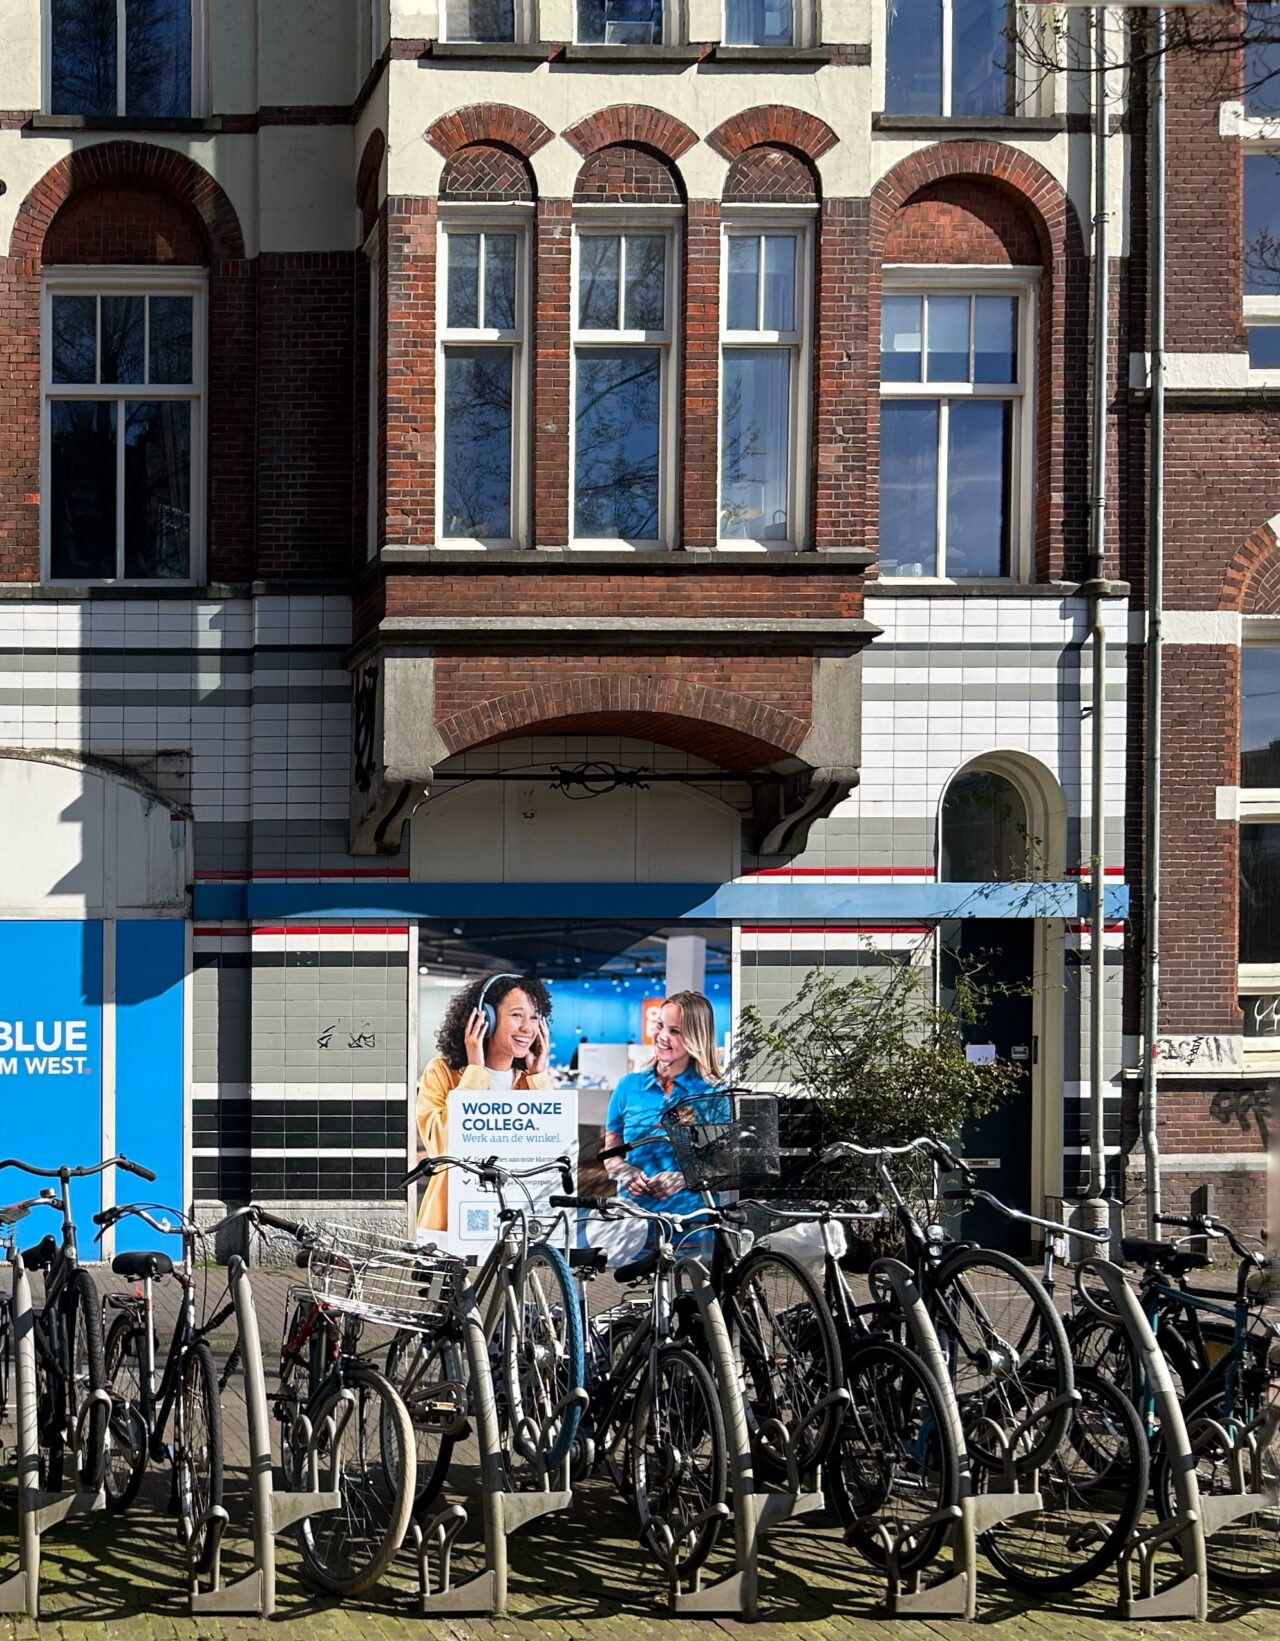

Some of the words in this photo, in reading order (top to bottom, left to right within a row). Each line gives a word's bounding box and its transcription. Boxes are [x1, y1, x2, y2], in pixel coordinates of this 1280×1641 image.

[462, 1102, 513, 1115] WORD
[517, 1102, 562, 1115] ONZE
[462, 1118, 540, 1131] COLLEGA.
[462, 1133, 487, 1143] Werk
[489, 1135, 509, 1143] aan
[511, 1133, 524, 1143] de
